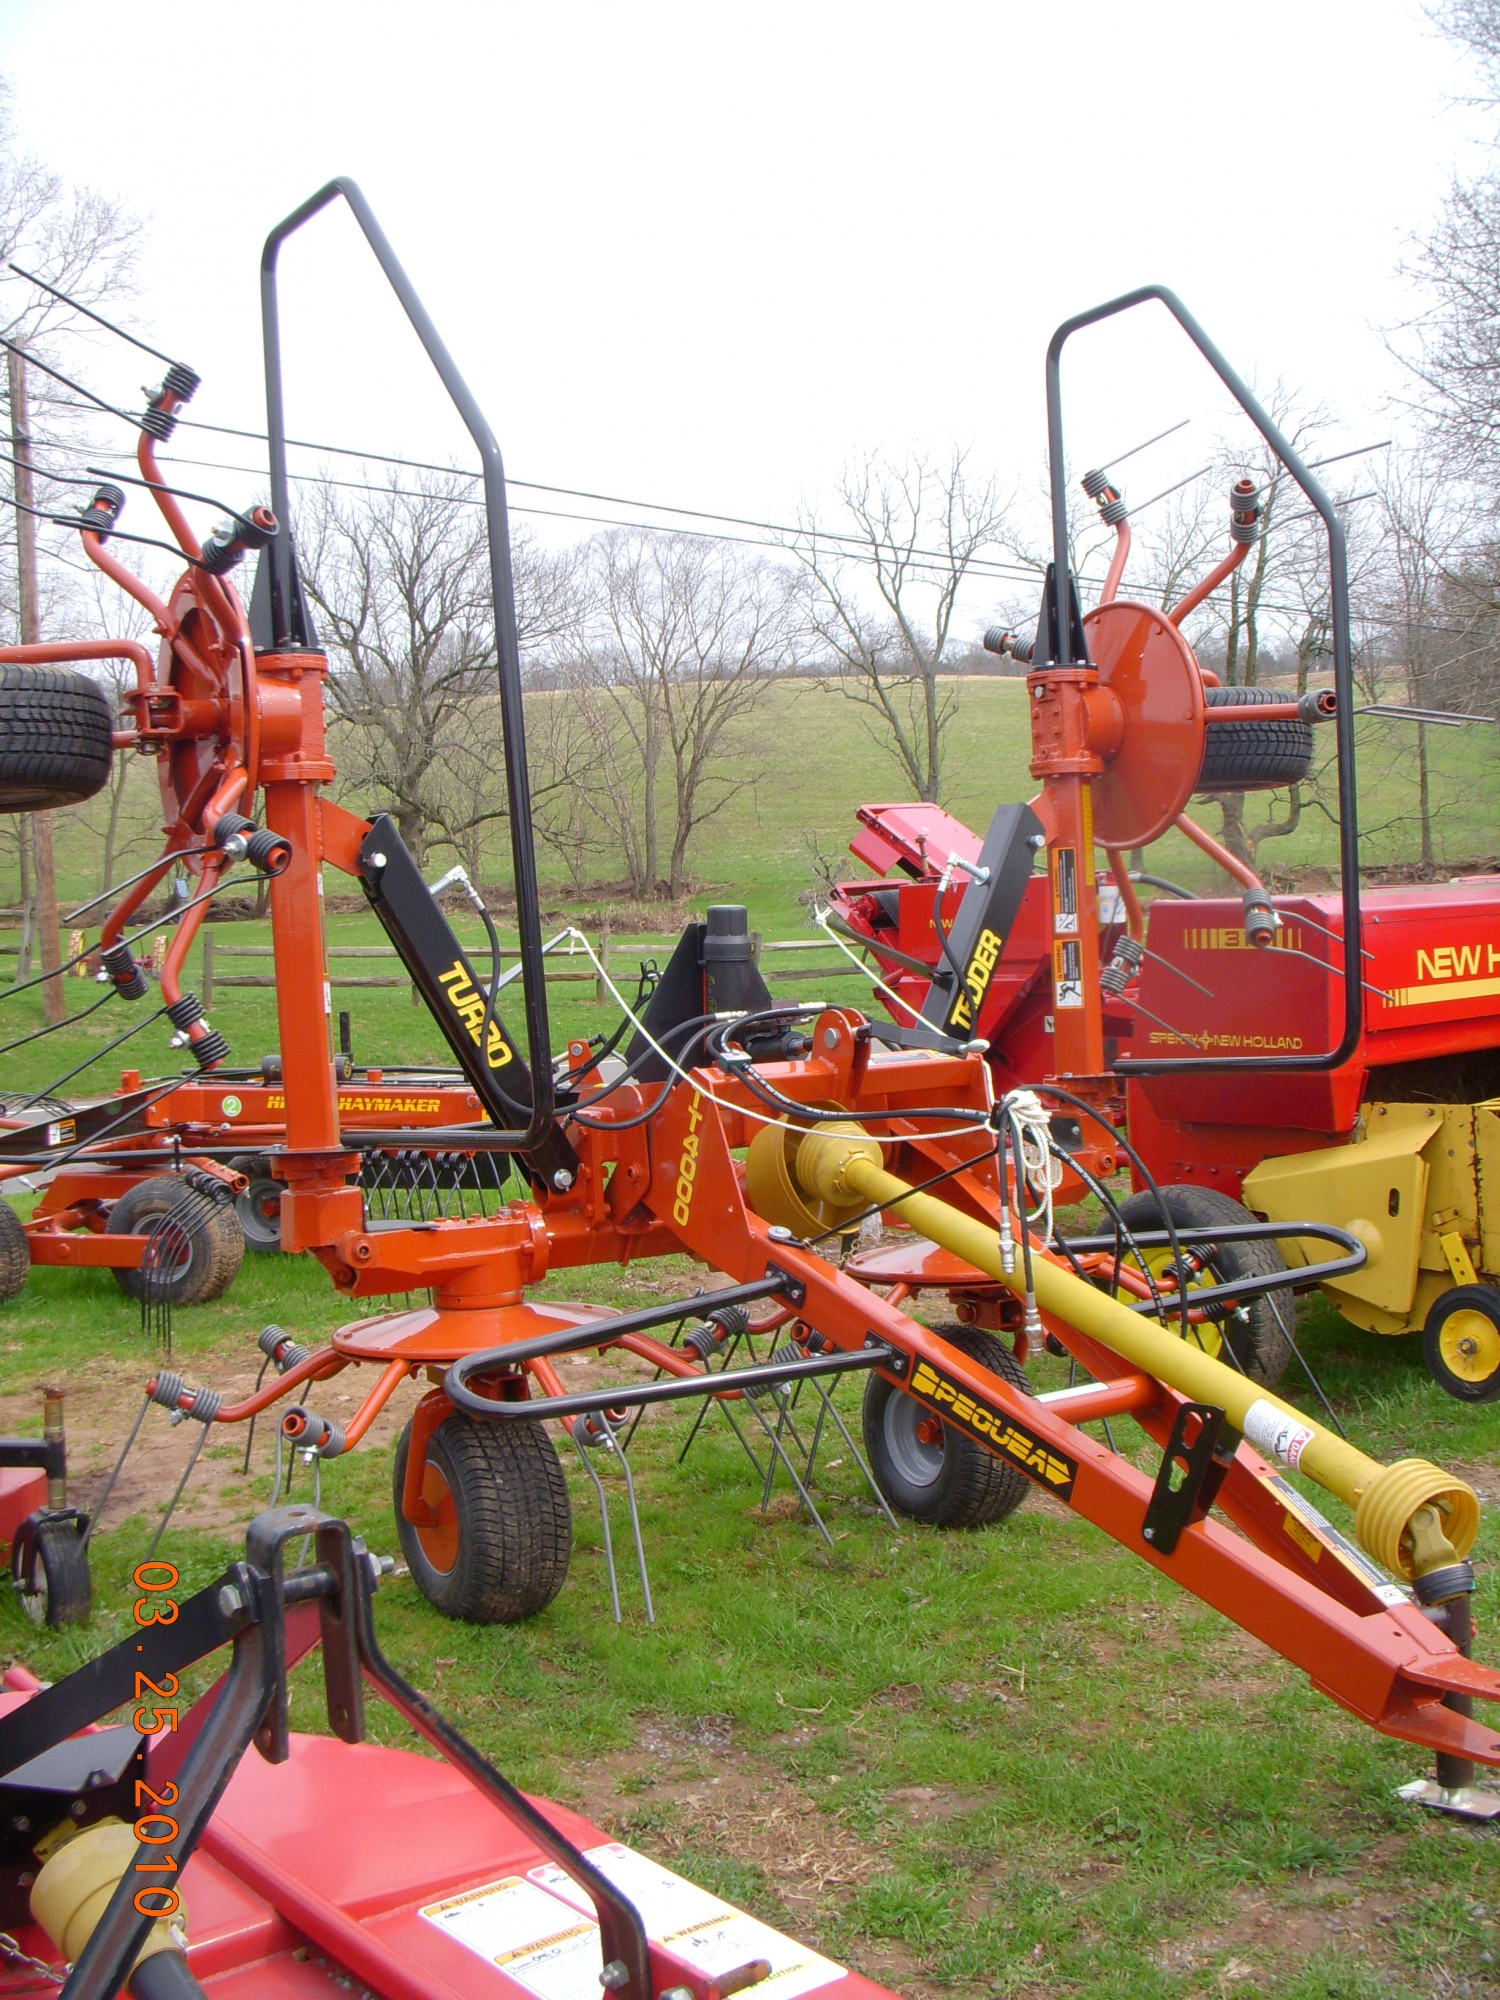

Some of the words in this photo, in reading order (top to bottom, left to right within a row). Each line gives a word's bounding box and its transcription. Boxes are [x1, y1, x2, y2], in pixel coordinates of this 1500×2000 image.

[929, 919, 954, 929] NW
[1417, 944, 1482, 981] NEW
[438, 960, 513, 1069] TURBO
[1150, 1031, 1200, 1046] SPERRY
[1213, 1034, 1241, 1047] NEW
[1243, 1035, 1303, 1050] HOLLAND
[227, 1100, 238, 1114] 2
[338, 1097, 441, 1113] HAYMAKER
[673, 1084, 706, 1227] TT4000
[934, 1380, 1047, 1475] PEQUEA
[452, 1883, 509, 1906] WARNING
[675, 1913, 731, 1938] WARNING
[524, 1927, 582, 1953] WARNING
